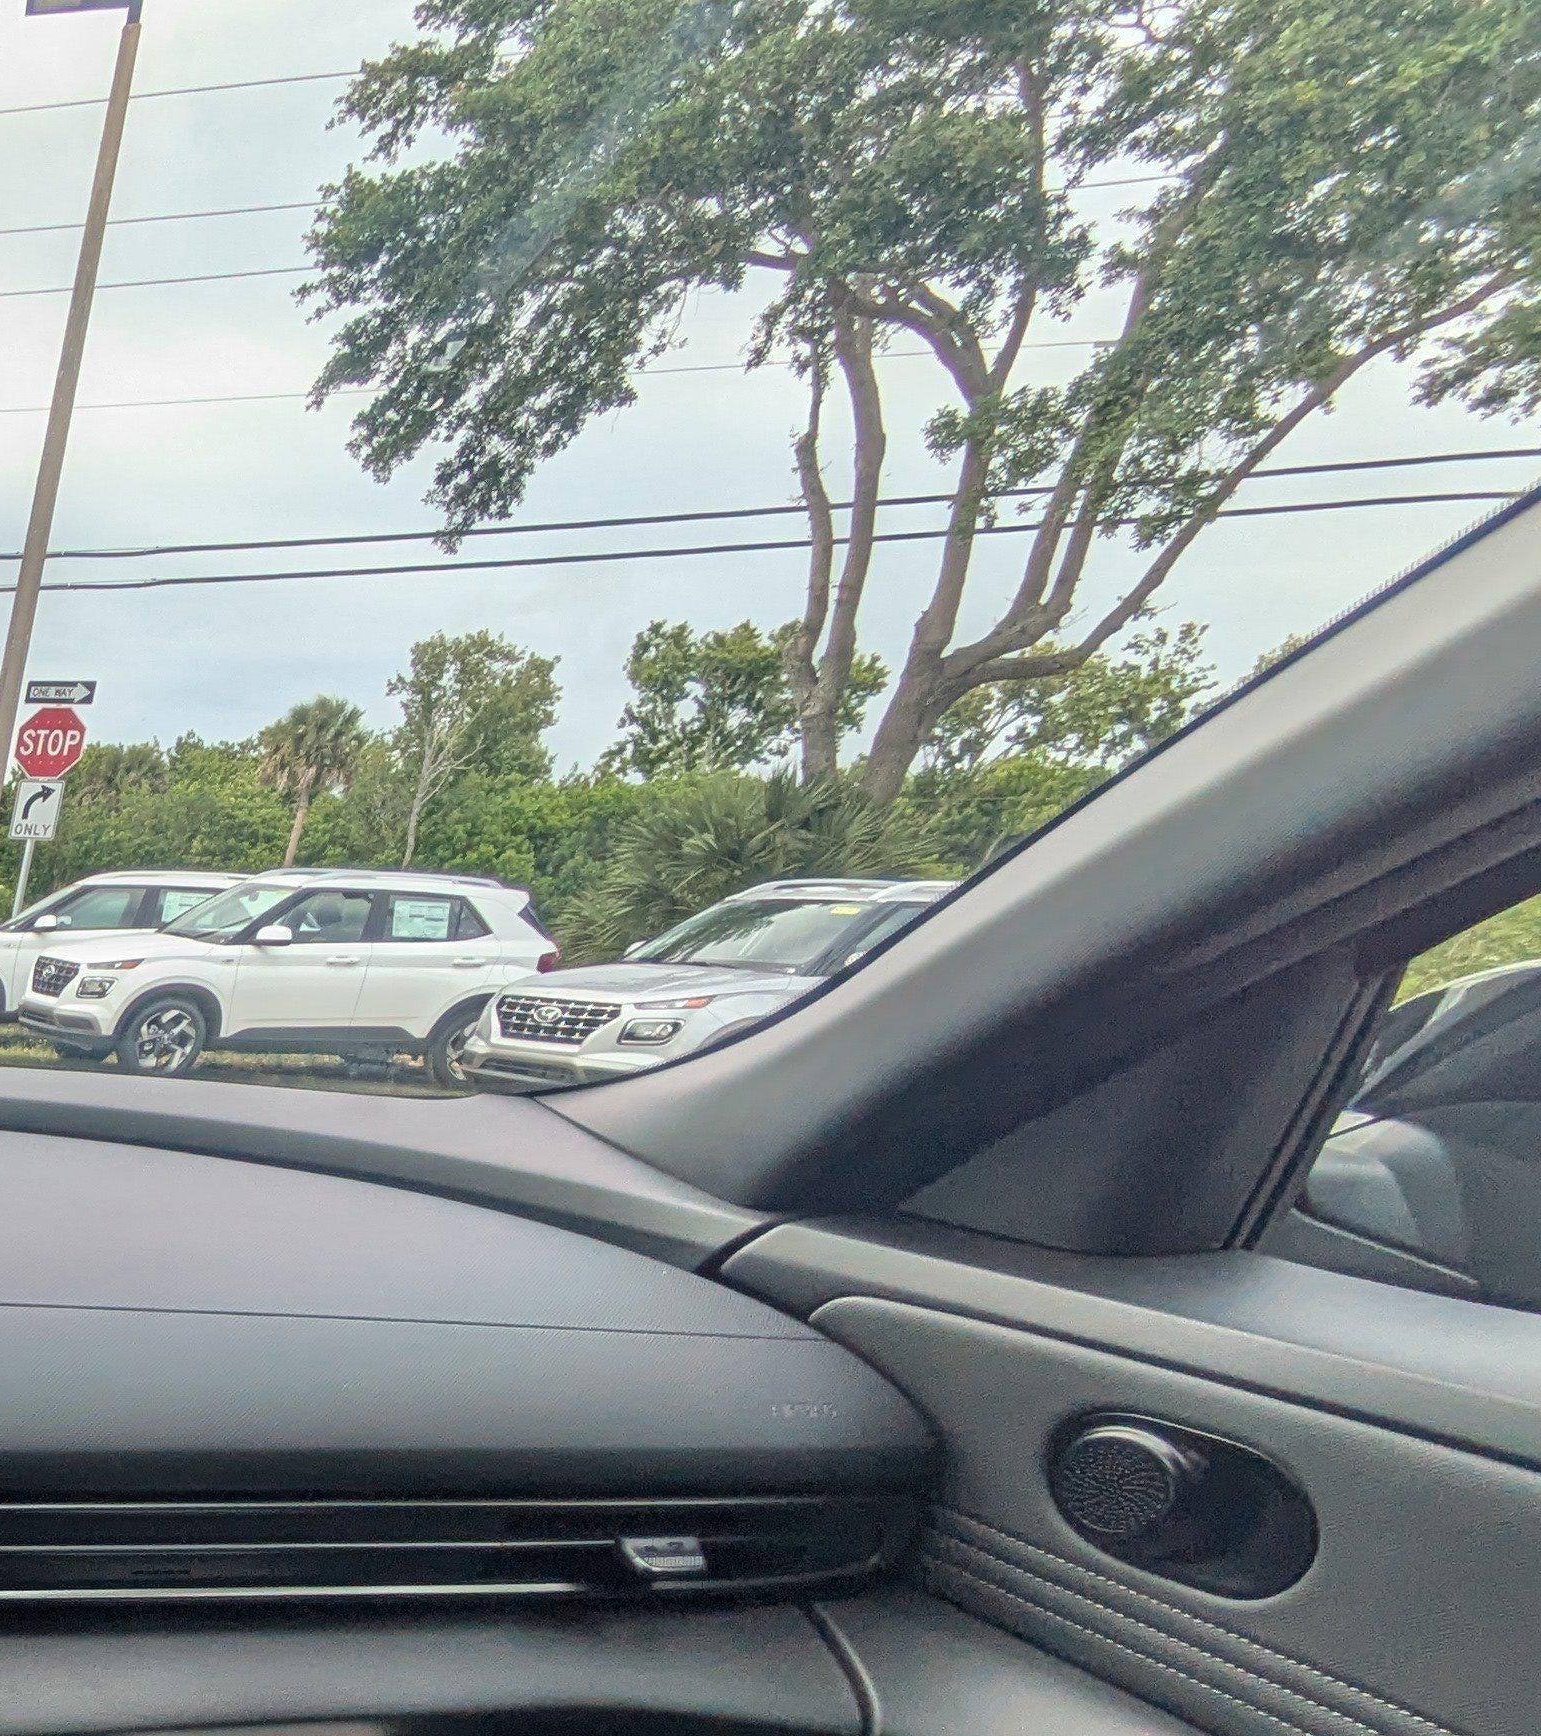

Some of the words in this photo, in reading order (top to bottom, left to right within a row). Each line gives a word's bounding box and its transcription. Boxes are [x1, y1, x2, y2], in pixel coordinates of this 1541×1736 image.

[32, 687, 52, 697] ONE
[54, 687, 74, 698] WAY
[19, 728, 81, 757] STOP
[13, 823, 52, 837] ONLY
